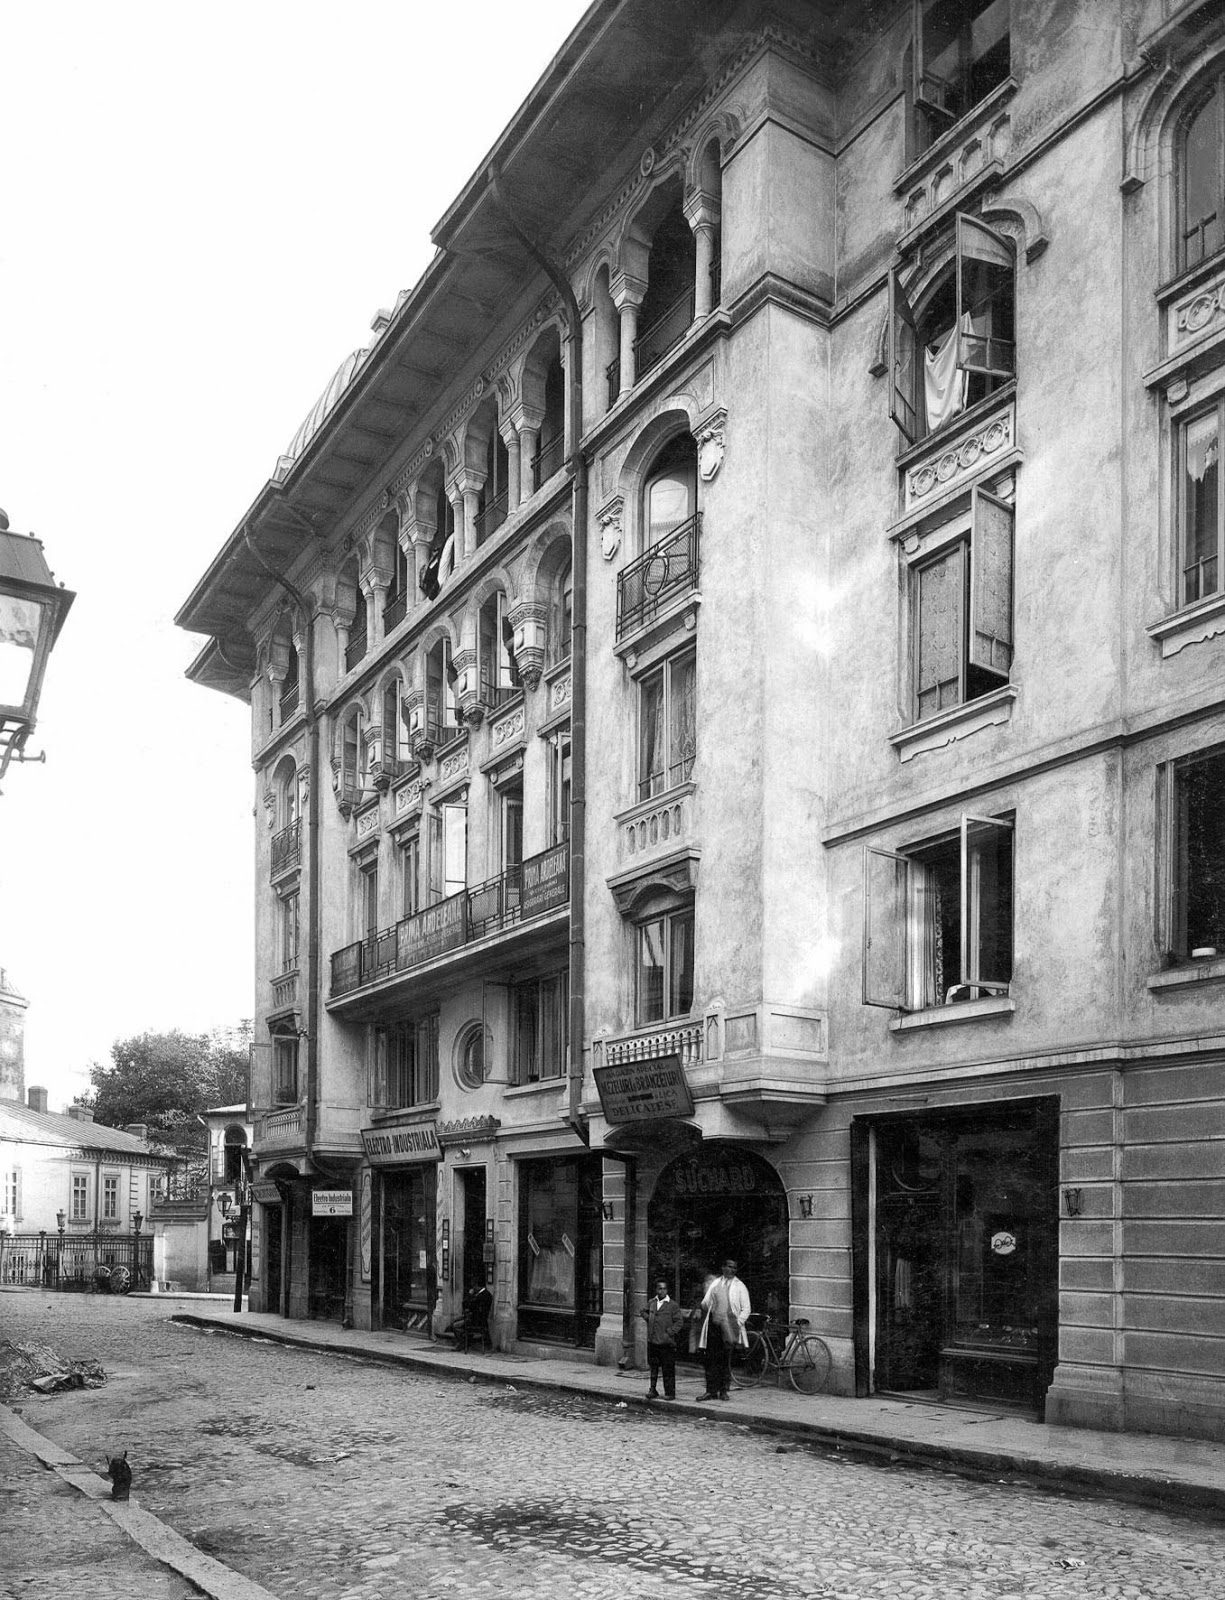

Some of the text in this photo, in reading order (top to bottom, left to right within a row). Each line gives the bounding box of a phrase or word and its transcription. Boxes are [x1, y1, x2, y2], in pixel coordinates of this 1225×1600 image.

[636, 1063, 665, 1074] SPECIAL
[675, 1165, 755, 1193] SUCHARD
[329, 1206, 336, 1214] 6
